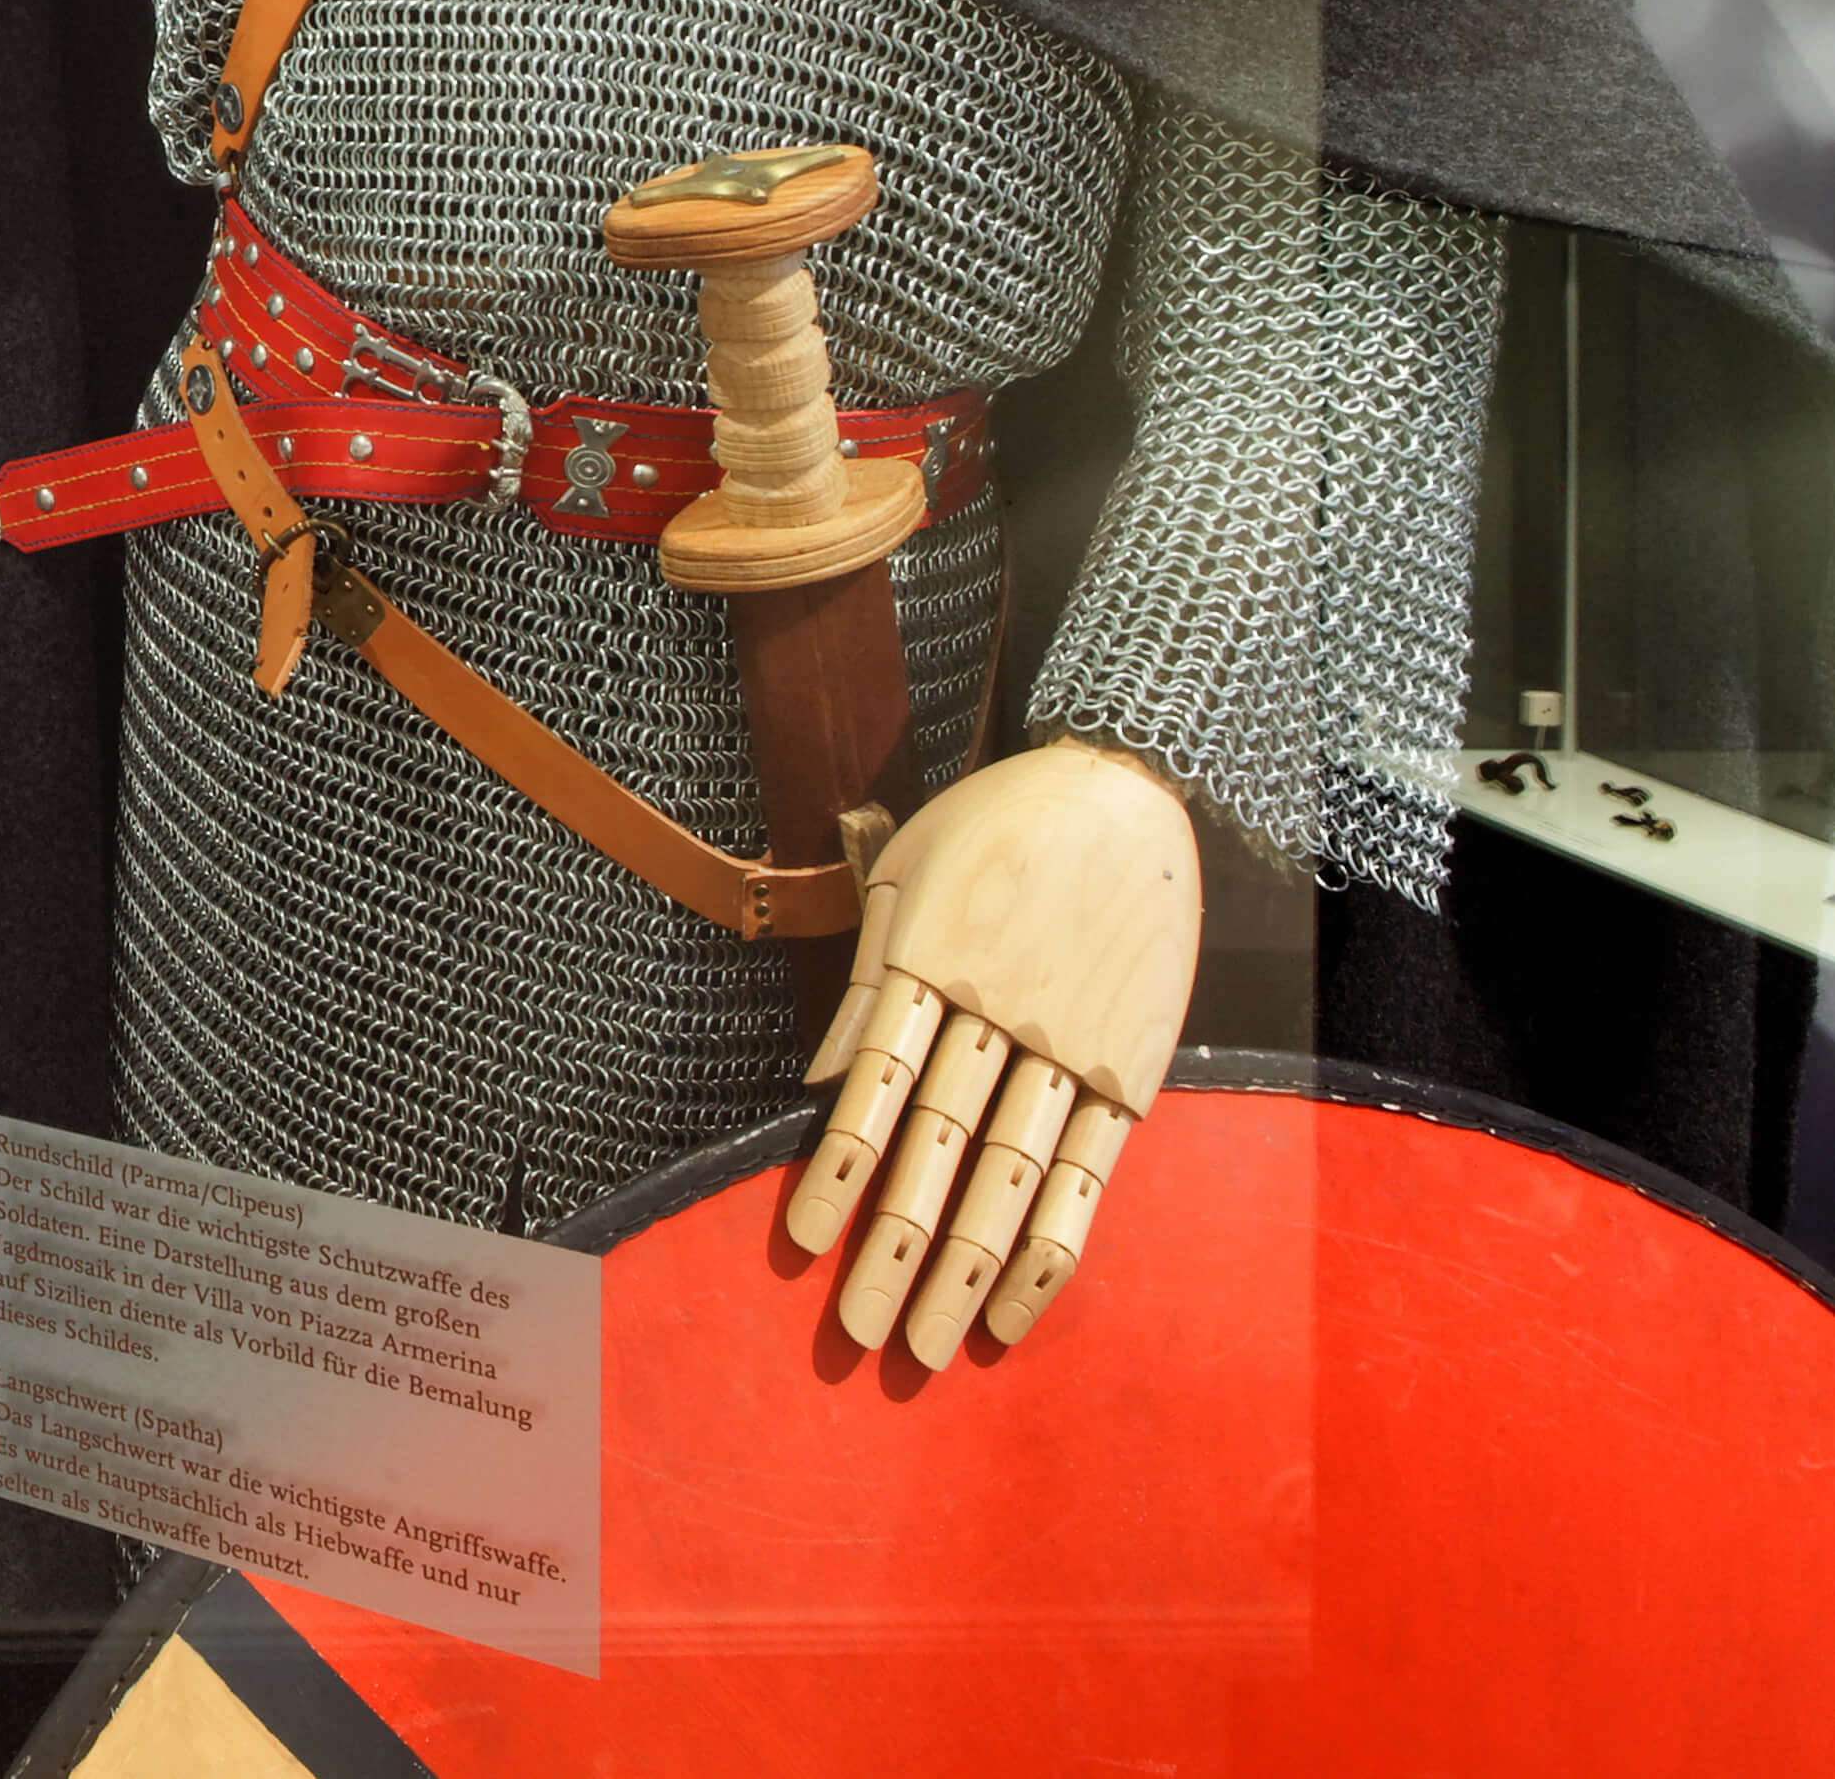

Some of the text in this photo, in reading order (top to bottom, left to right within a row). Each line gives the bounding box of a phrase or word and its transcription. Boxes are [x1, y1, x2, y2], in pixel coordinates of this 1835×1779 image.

[39, 1177, 105, 1211] Schild
[110, 1198, 150, 1222] war
[156, 1204, 190, 1232] die
[196, 1219, 310, 1260] wichtigste
[318, 1244, 461, 1297] Schutzwaffe
[468, 1279, 510, 1310] des
[121, 1163, 303, 1228] (Parma/Clipeus)
[98, 1224, 145, 1255] Eine
[153, 1238, 282, 1295] Darstellung
[288, 1277, 328, 1301] aus
[335, 1283, 387, 1316] dem
[394, 1304, 480, 1339] großen
[122, 1264, 144, 1289] in
[150, 1271, 187, 1300] der
[193, 1282, 243, 1315] Villa
[250, 1302, 292, 1327] von
[299, 1309, 373, 1348] Piazza
[381, 1333, 496, 1379] Armerina
[33, 1277, 112, 1315] Sizilien
[118, 1298, 186, 1334] diente
[193, 1319, 223, 1345] als
[230, 1327, 314, 1368] Vorbild
[322, 1350, 357, 1379] für
[363, 1361, 400, 1391] die
[408, 1373, 532, 1432] Bemalung
[64, 1318, 158, 1362] Schildes.
[133, 1406, 223, 1454] (Spatha)
[24, 1448, 89, 1479] wurde
[97, 1463, 247, 1525] hauptsächlich
[254, 1511, 286, 1537] als
[294, 1521, 413, 1574] Hiebwaffe
[420, 1563, 468, 1591] und
[476, 1579, 521, 1606] nur
[41, 1414, 174, 1470] Langschwert
[180, 1458, 222, 1483] war
[227, 1466, 262, 1495] die
[269, 1483, 385, 1530] wichtigste
[393, 1516, 565, 1582] Angriffswaffe.
[60, 1489, 90, 1514] als
[97, 1498, 210, 1550] Stichwaffe
[217, 1531, 309, 1579] benutzt.
